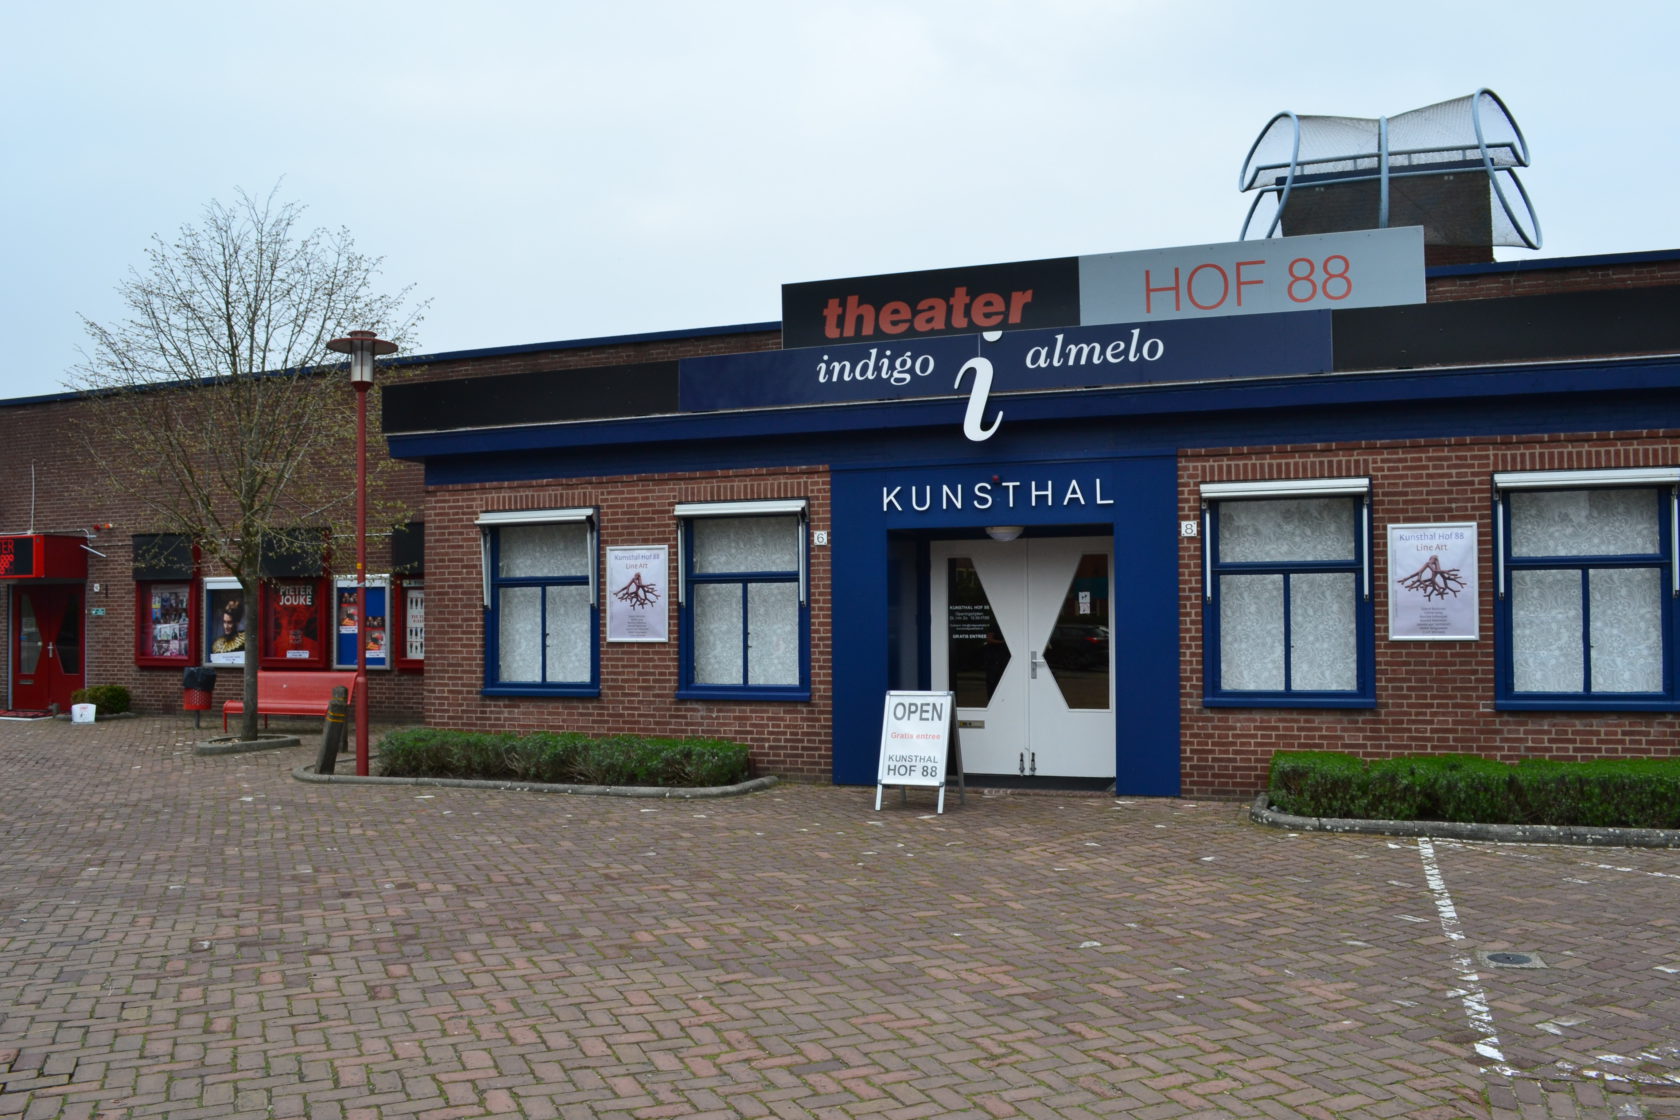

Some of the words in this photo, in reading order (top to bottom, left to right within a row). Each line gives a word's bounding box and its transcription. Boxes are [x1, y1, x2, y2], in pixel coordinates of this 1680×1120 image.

[1145, 260, 1266, 314] HOF
[1287, 255, 1353, 303] 88
[823, 286, 1033, 339] theater
[816, 348, 935, 386] indigo
[954, 330, 1004, 442] i
[1025, 328, 1164, 369] almelo
[883, 478, 1114, 512] KUNSTHAL
[1185, 523, 1194, 535] 8
[816, 531, 825, 544] 6
[1399, 532, 1436, 541] Kunsthal
[1438, 532, 1453, 541] Hof
[1454, 532, 1465, 540] 88
[1416, 544, 1433, 552] Line
[279, 595, 312, 605] JOUKE
[893, 702, 944, 722] OPEN
[890, 732, 914, 740] Gratis
[915, 732, 941, 740] entree
[888, 754, 939, 763] KUNSTHAL
[887, 764, 917, 777] HOF
[921, 765, 938, 778] 88
